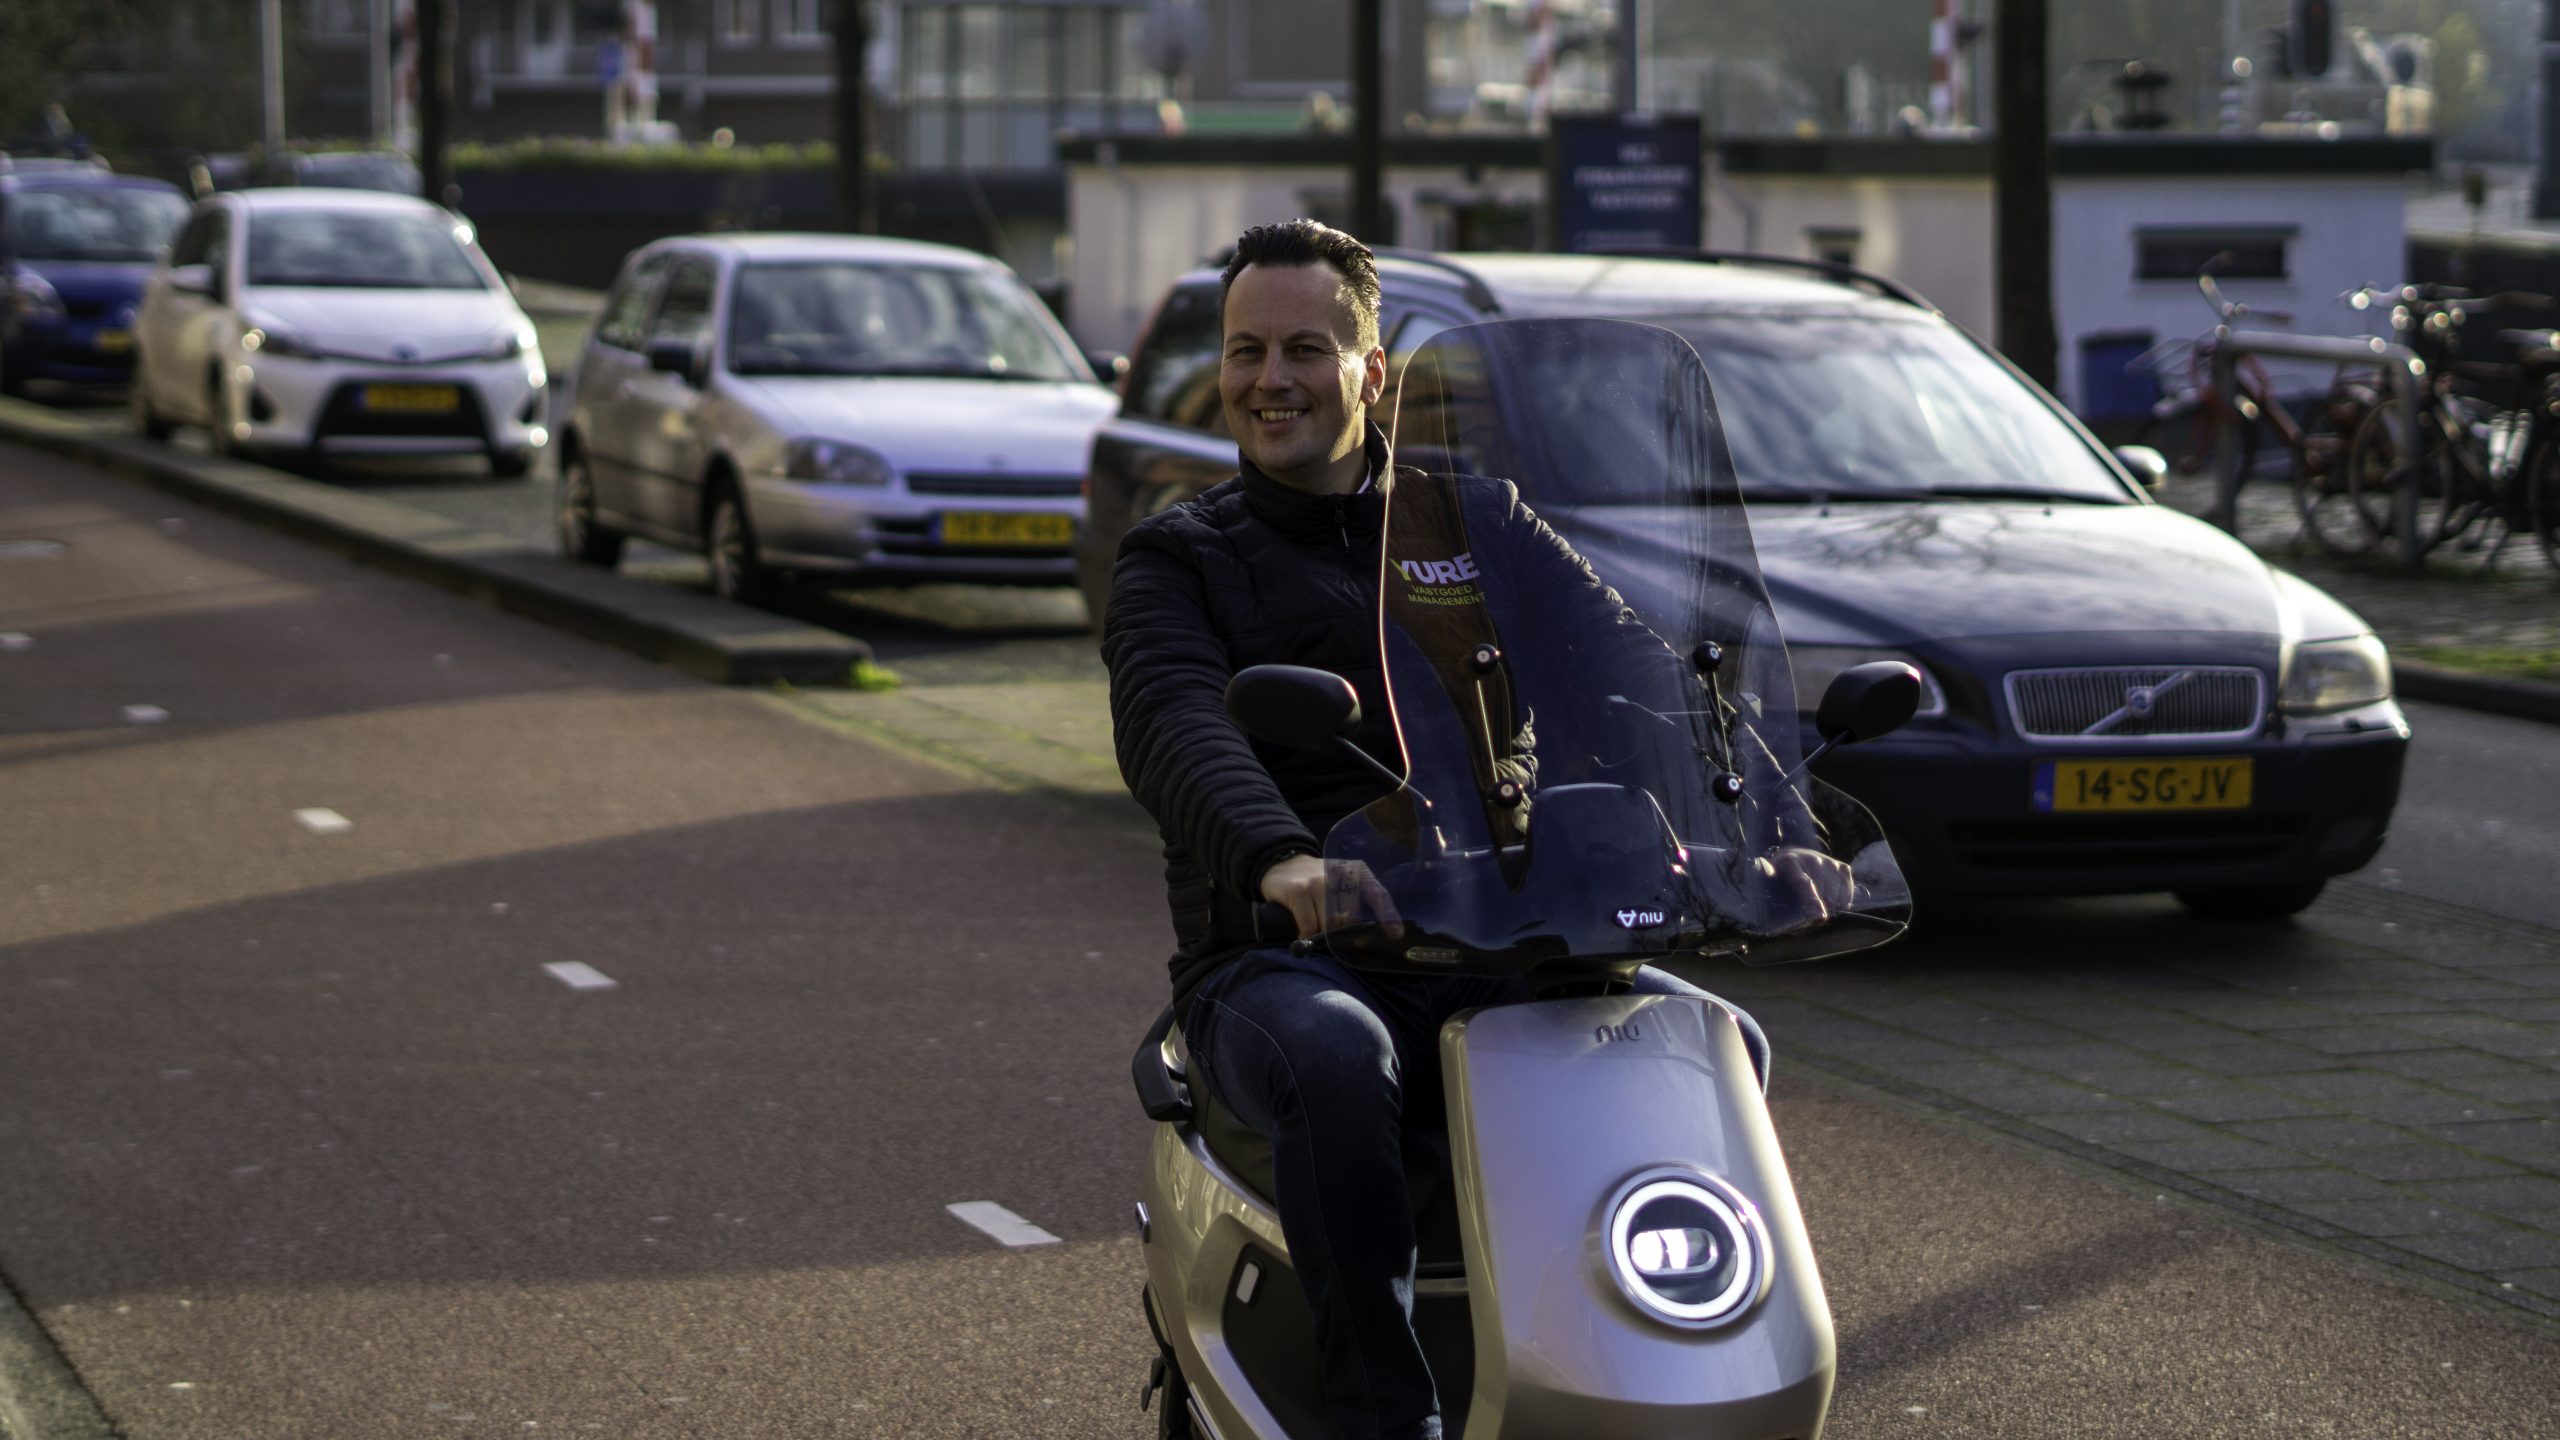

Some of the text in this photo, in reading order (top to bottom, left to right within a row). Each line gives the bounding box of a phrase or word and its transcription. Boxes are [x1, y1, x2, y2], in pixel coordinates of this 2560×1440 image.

[1388, 552, 1480, 584] YURE
[1407, 592, 1486, 606] MANAGEMENT
[1412, 584, 1472, 596] VASTGOED
[2076, 766, 2234, 803] 14-SG-JV
